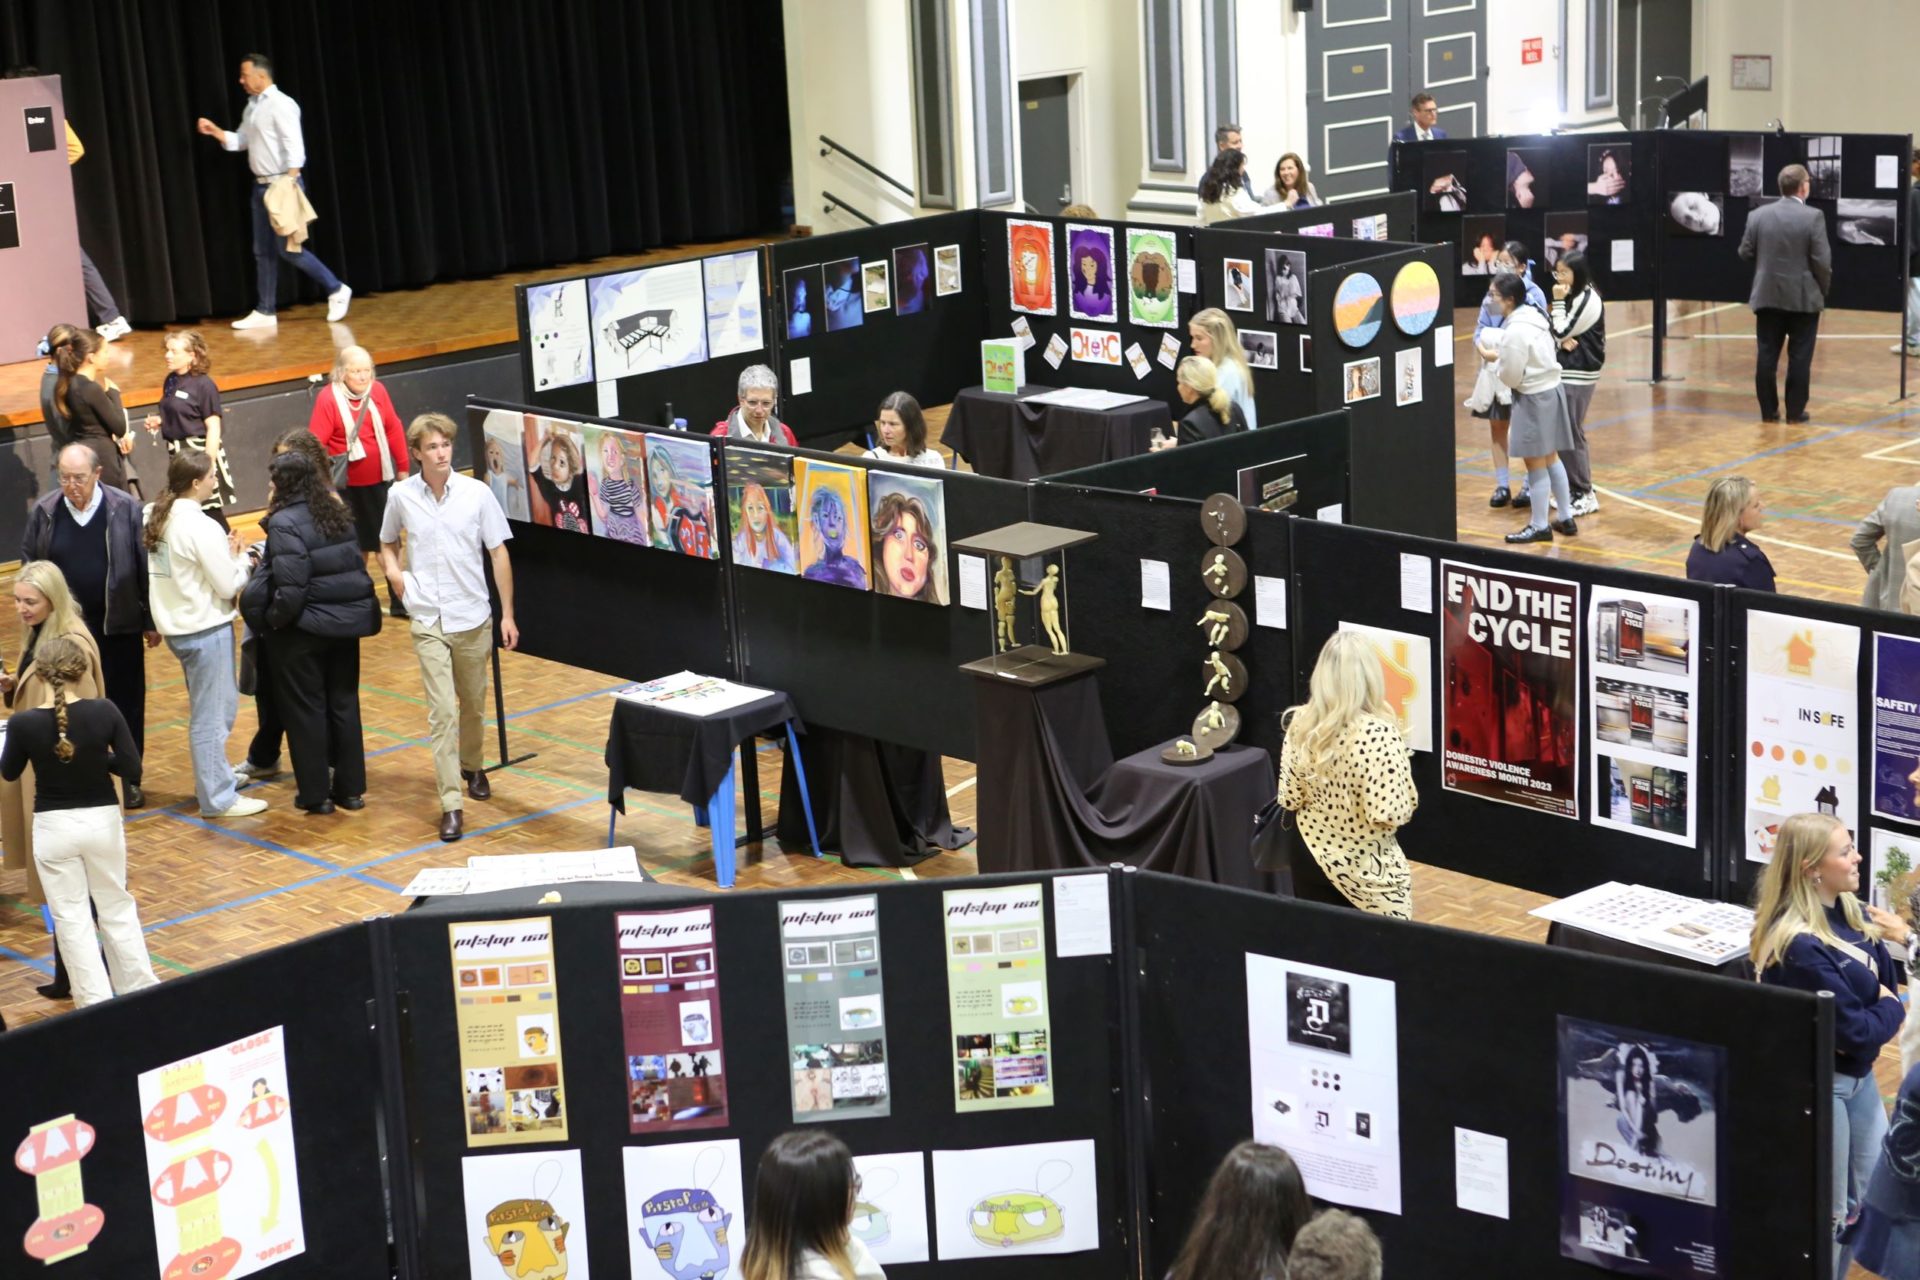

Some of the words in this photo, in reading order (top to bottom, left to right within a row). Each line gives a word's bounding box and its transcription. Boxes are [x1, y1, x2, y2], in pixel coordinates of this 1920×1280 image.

[1448, 571, 1513, 612] END
[1515, 588, 1572, 623] THE
[1468, 612, 1571, 659] CYCLE
[1799, 708, 1811, 722] IN
[1876, 697, 1917, 713] SAFETY
[1446, 750, 1488, 767] DOMESTIC
[1489, 760, 1531, 777] VIOLENCE
[1446, 760, 1497, 779] AWARENESS
[1498, 771, 1529, 786] MONTH
[1530, 779, 1552, 791] 2023
